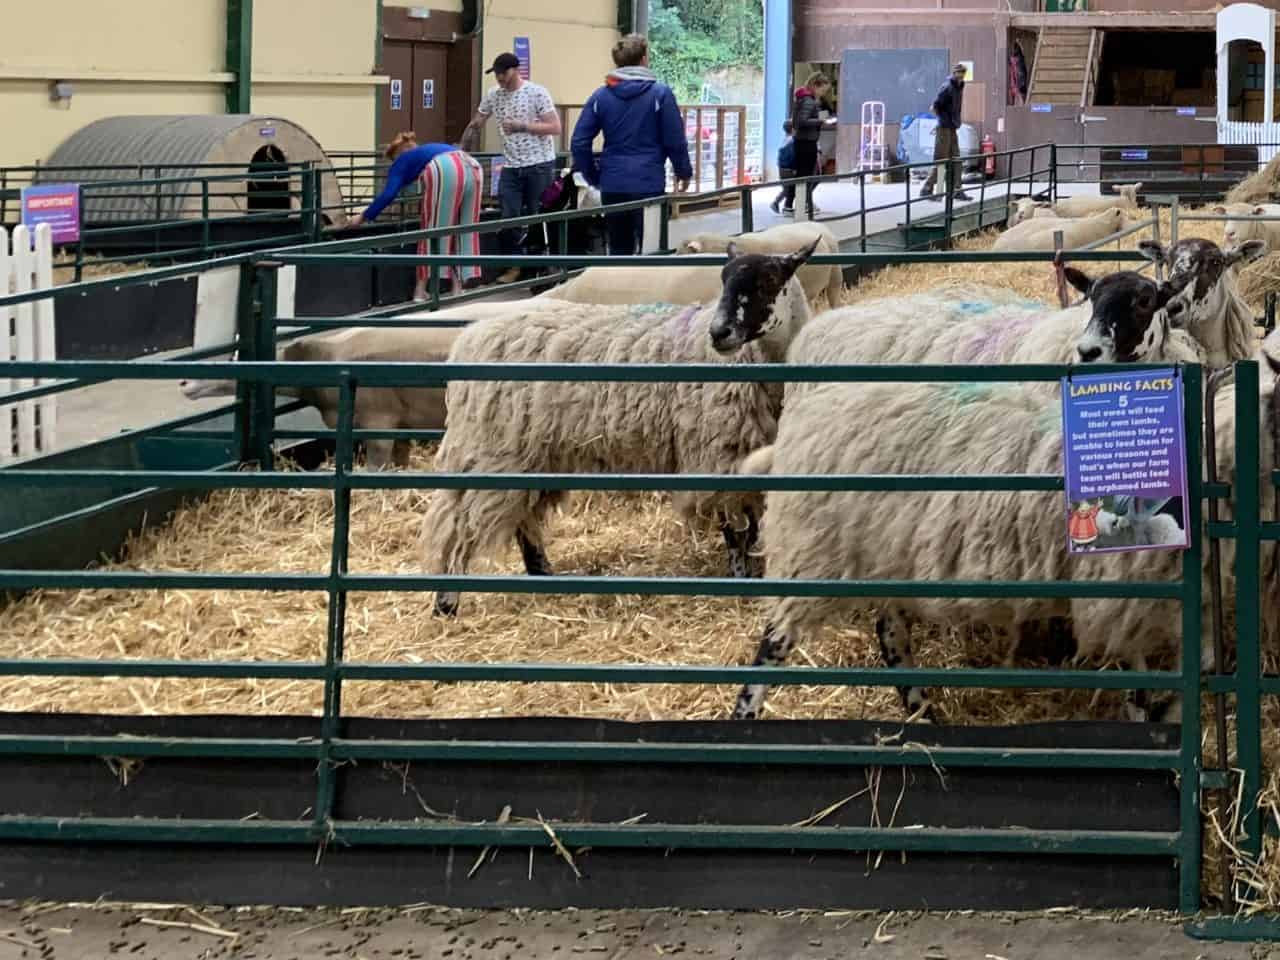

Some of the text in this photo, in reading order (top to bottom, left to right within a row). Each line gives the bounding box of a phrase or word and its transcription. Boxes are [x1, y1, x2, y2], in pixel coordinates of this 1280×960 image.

[1070, 378, 1174, 397] LAMBING FACTS
[1118, 395, 1128, 407] 5
[1080, 410, 1101, 418] Most
[1128, 406, 1143, 415] will
[1145, 405, 1165, 414] feed
[1088, 420, 1108, 429] their
[1072, 426, 1174, 440] but sometimes they are
[1073, 437, 1174, 451] unable to feed them for
[1080, 447, 1168, 461] various reasons and
[1106, 461, 1130, 470] when
[1132, 460, 1147, 468] our
[1149, 458, 1169, 467] farm
[1080, 468, 1169, 483] team will bottle feed
[1080, 484, 1095, 493] the
[1097, 482, 1139, 493] orphaned
